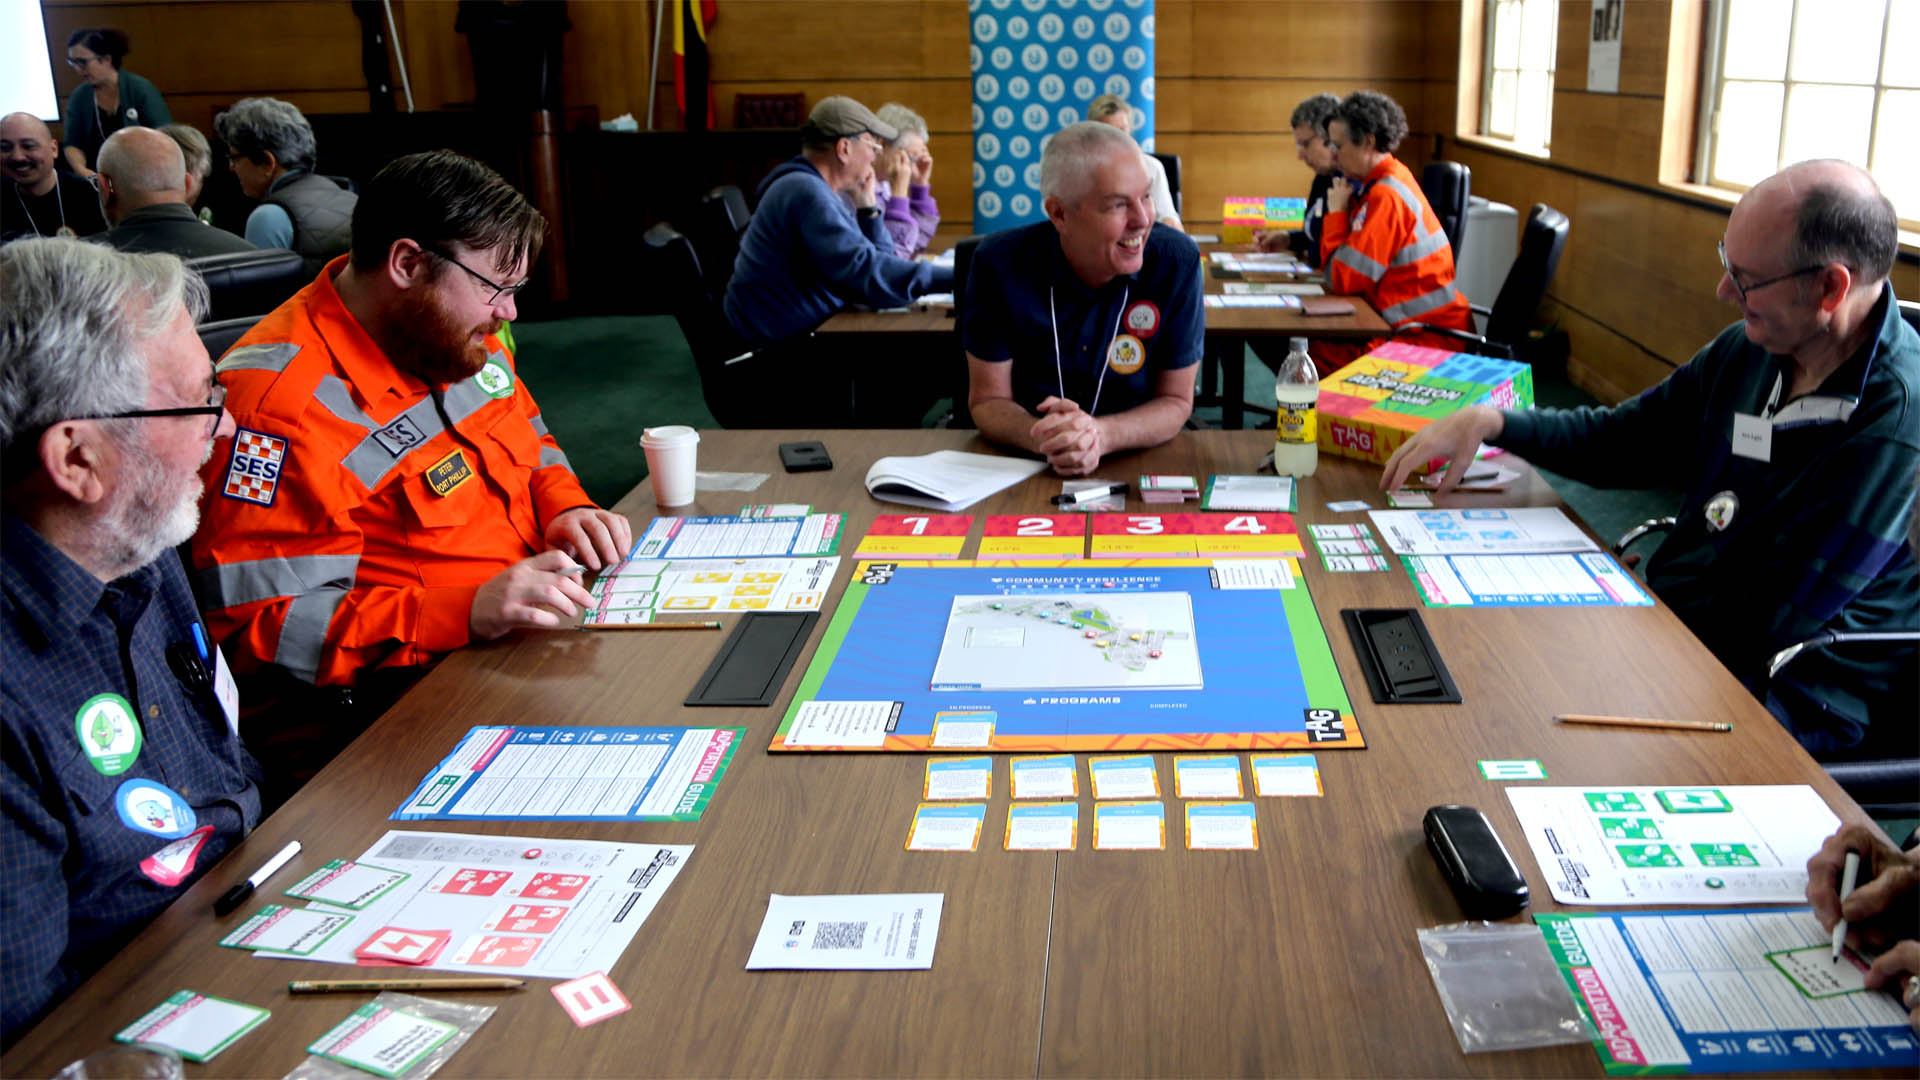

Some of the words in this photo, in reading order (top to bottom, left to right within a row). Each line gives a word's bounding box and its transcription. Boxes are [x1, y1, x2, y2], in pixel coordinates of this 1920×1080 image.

[1333, 425, 1372, 450] TAG
[233, 455, 278, 479] SES
[438, 461, 455, 476] PETER
[448, 466, 467, 485] PHILLIP
[903, 517, 929, 535] 1
[1017, 517, 1054, 536] 2
[1126, 516, 1164, 534] 3
[1224, 516, 1267, 534] 4
[864, 564, 894, 584] TAG
[1040, 696, 1121, 705] PROGRAMS
[1305, 710, 1345, 741] TAG
[693, 730, 733, 782] ADAPTATION
[675, 783, 705, 814] GUIDE
[1551, 920, 1588, 966] GUIDE
[1575, 968, 1639, 1062] ADAPTATION
